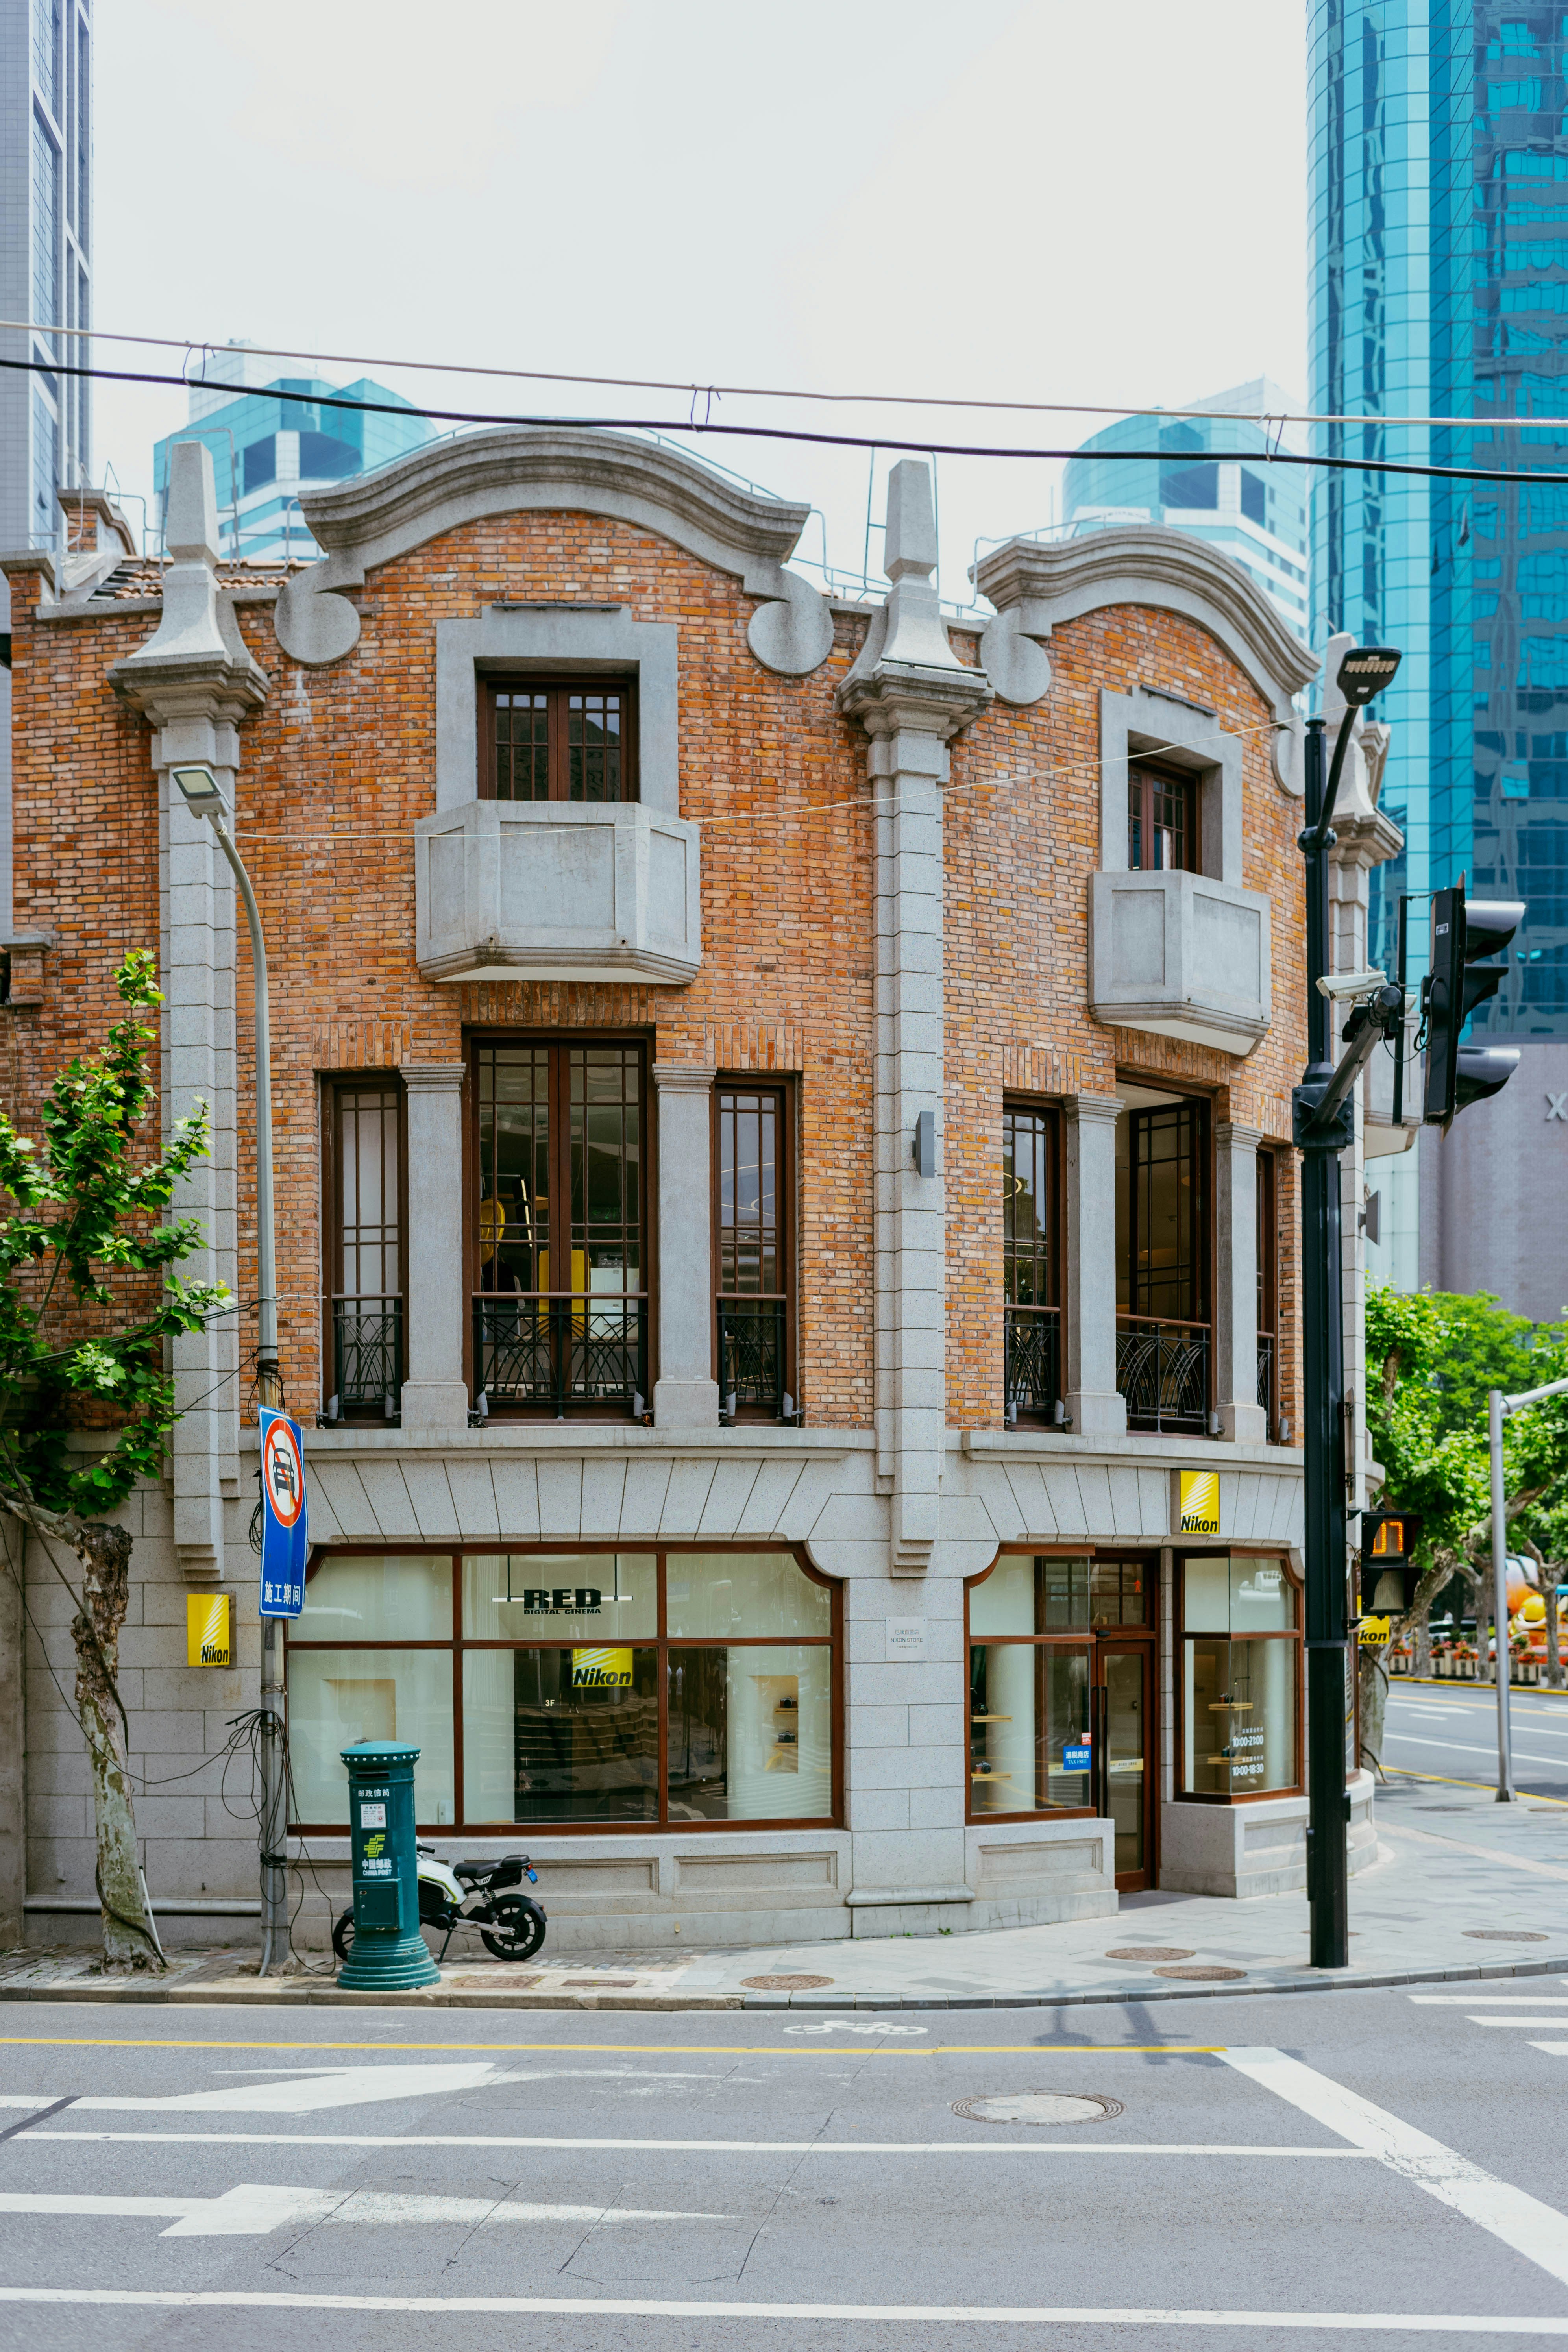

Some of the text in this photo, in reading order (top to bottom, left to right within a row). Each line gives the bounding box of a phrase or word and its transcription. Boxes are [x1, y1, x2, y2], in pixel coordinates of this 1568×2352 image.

[1181, 1516, 1218, 1532] Nikon
[264, 1581, 300, 1606] 施工期间
[524, 1589, 601, 1609] RED
[1360, 1630, 1387, 1642] kon
[202, 1645, 228, 1663] Nikon
[573, 1668, 631, 1685] Nikon
[1232, 1735, 1264, 1747] 10:00-21:00
[1066, 1751, 1089, 1759] 退税商店
[1232, 1764, 1264, 1776] 10:00-18:30
[358, 1788, 390, 1797] 邮政信筒
[362, 1858, 392, 1869] 中国邮政
